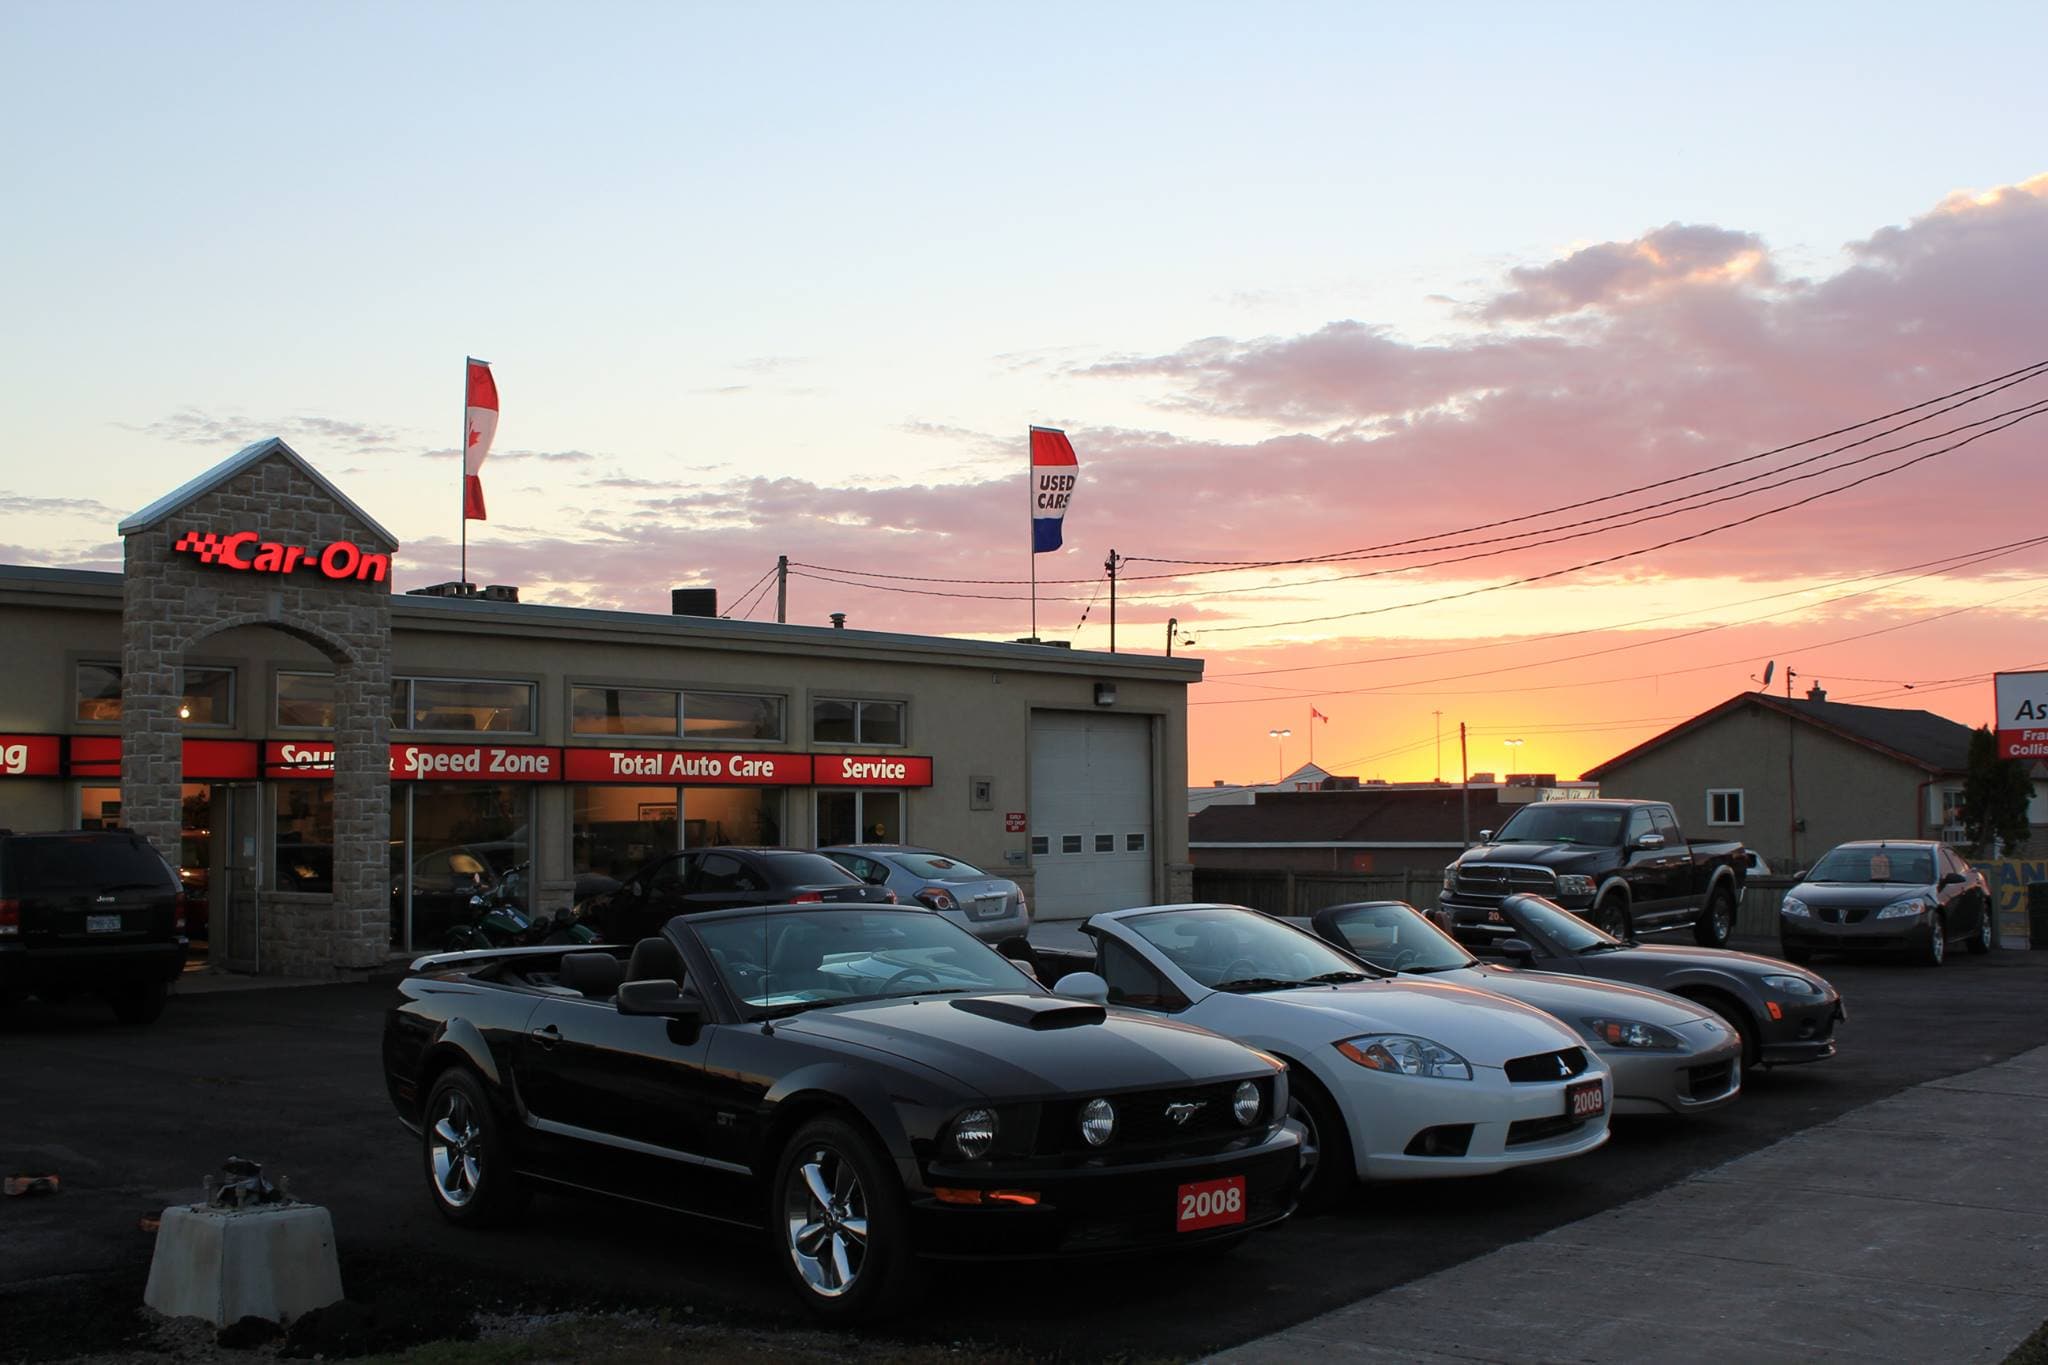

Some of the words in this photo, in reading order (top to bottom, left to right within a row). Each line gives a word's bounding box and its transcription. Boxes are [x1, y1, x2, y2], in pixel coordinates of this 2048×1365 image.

[1040, 475, 1076, 491] USED
[1037, 493, 1071, 509] CARS
[222, 531, 388, 582] Car-On
[2023, 730, 2048, 740] Fra
[404, 747, 481, 780] Speed
[489, 749, 550, 773] Zone
[609, 752, 663, 775] Total
[669, 754, 722, 777] Auto
[728, 755, 775, 777] Care
[842, 757, 906, 779] Service
[1573, 1089, 1602, 1114] 2009
[1181, 1187, 1241, 1220] 2008
